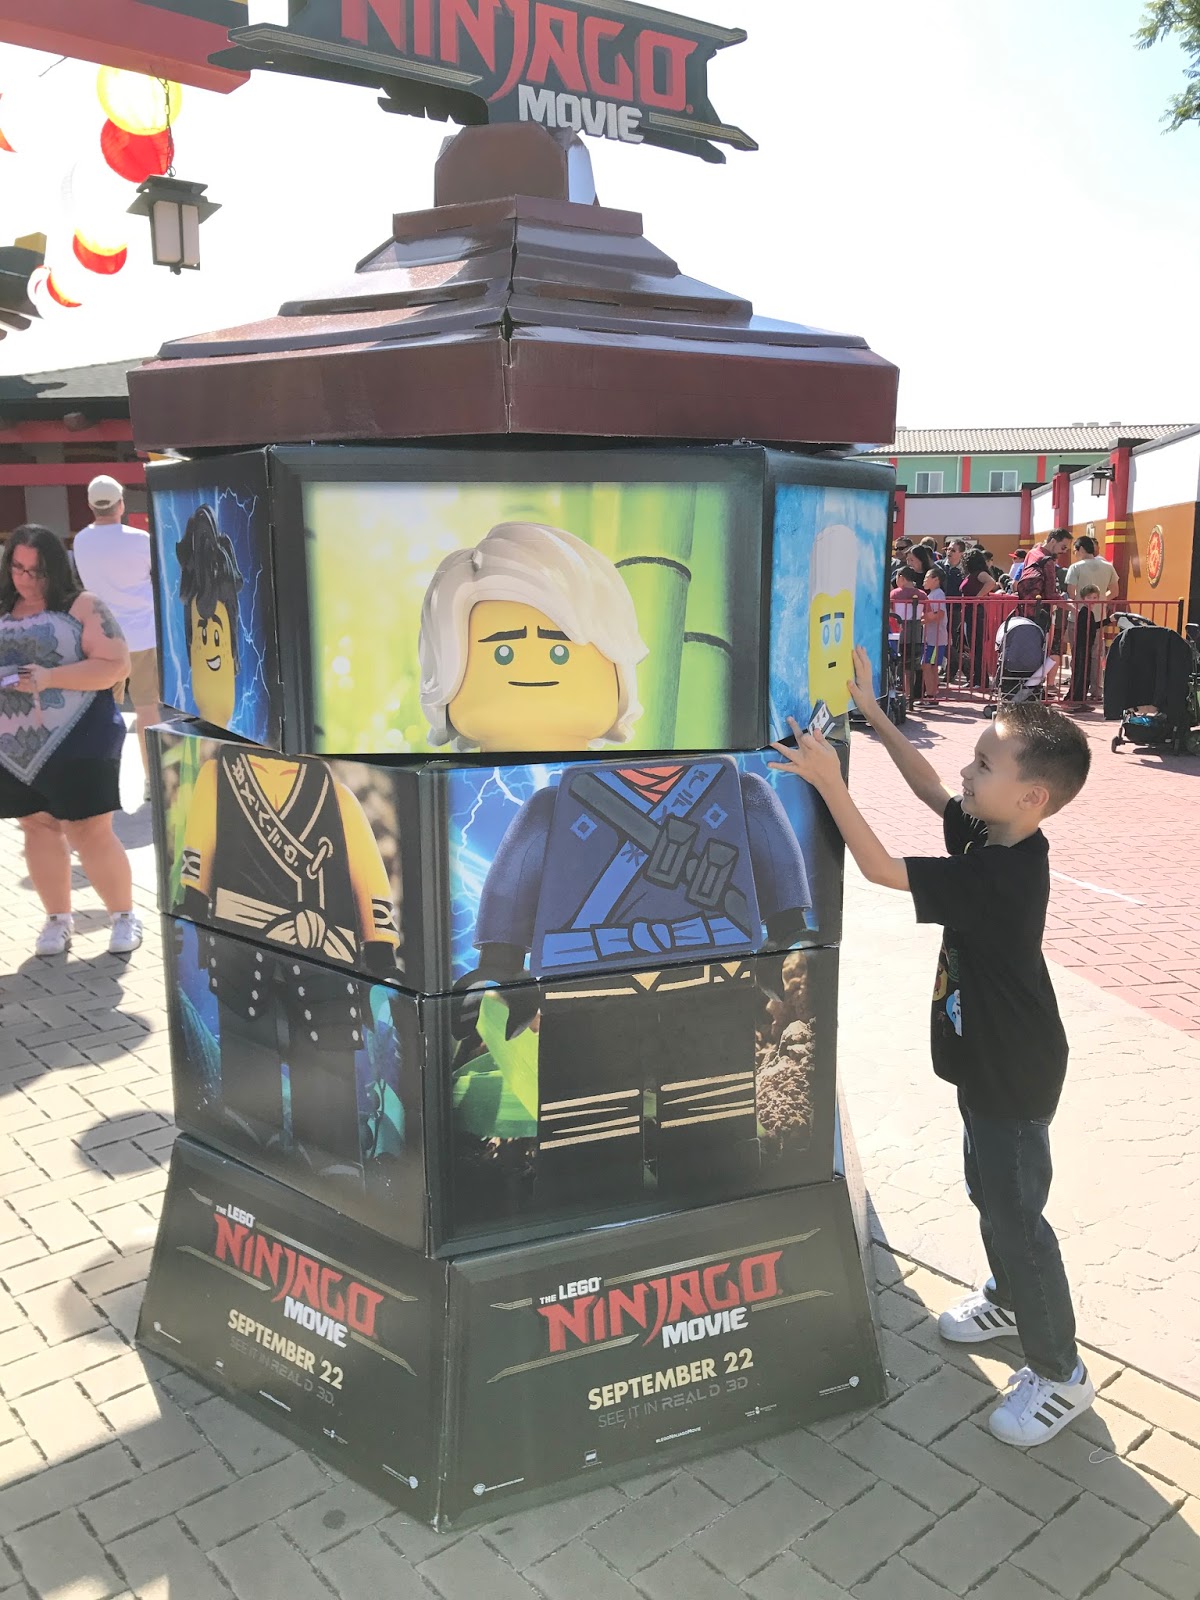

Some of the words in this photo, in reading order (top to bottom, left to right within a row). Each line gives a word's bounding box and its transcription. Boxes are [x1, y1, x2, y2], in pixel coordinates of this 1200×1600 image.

[517, 83, 645, 144] MOVIE
[216, 1204, 227, 1216] THE
[228, 1203, 256, 1228] LEGO
[213, 1212, 385, 1338] NINJAGO
[537, 1250, 783, 1353] NINJAGO
[539, 1293, 558, 1305] THE
[558, 1277, 602, 1301] LEGO
[228, 1308, 316, 1375] SEPTEMBER
[319, 1360, 345, 1391] 22
[283, 1295, 348, 1349] MOVIE
[661, 1306, 750, 1349] MOVIE
[229, 1336, 248, 1356] SEE
[316, 1385, 335, 1406] 3D
[587, 1358, 717, 1411] SEPTEMBER
[723, 1347, 754, 1374] 22
[597, 1408, 626, 1429] SEE
[628, 1407, 641, 1421] IT
[644, 1400, 659, 1416] IN
[725, 1376, 750, 1393] 3D
